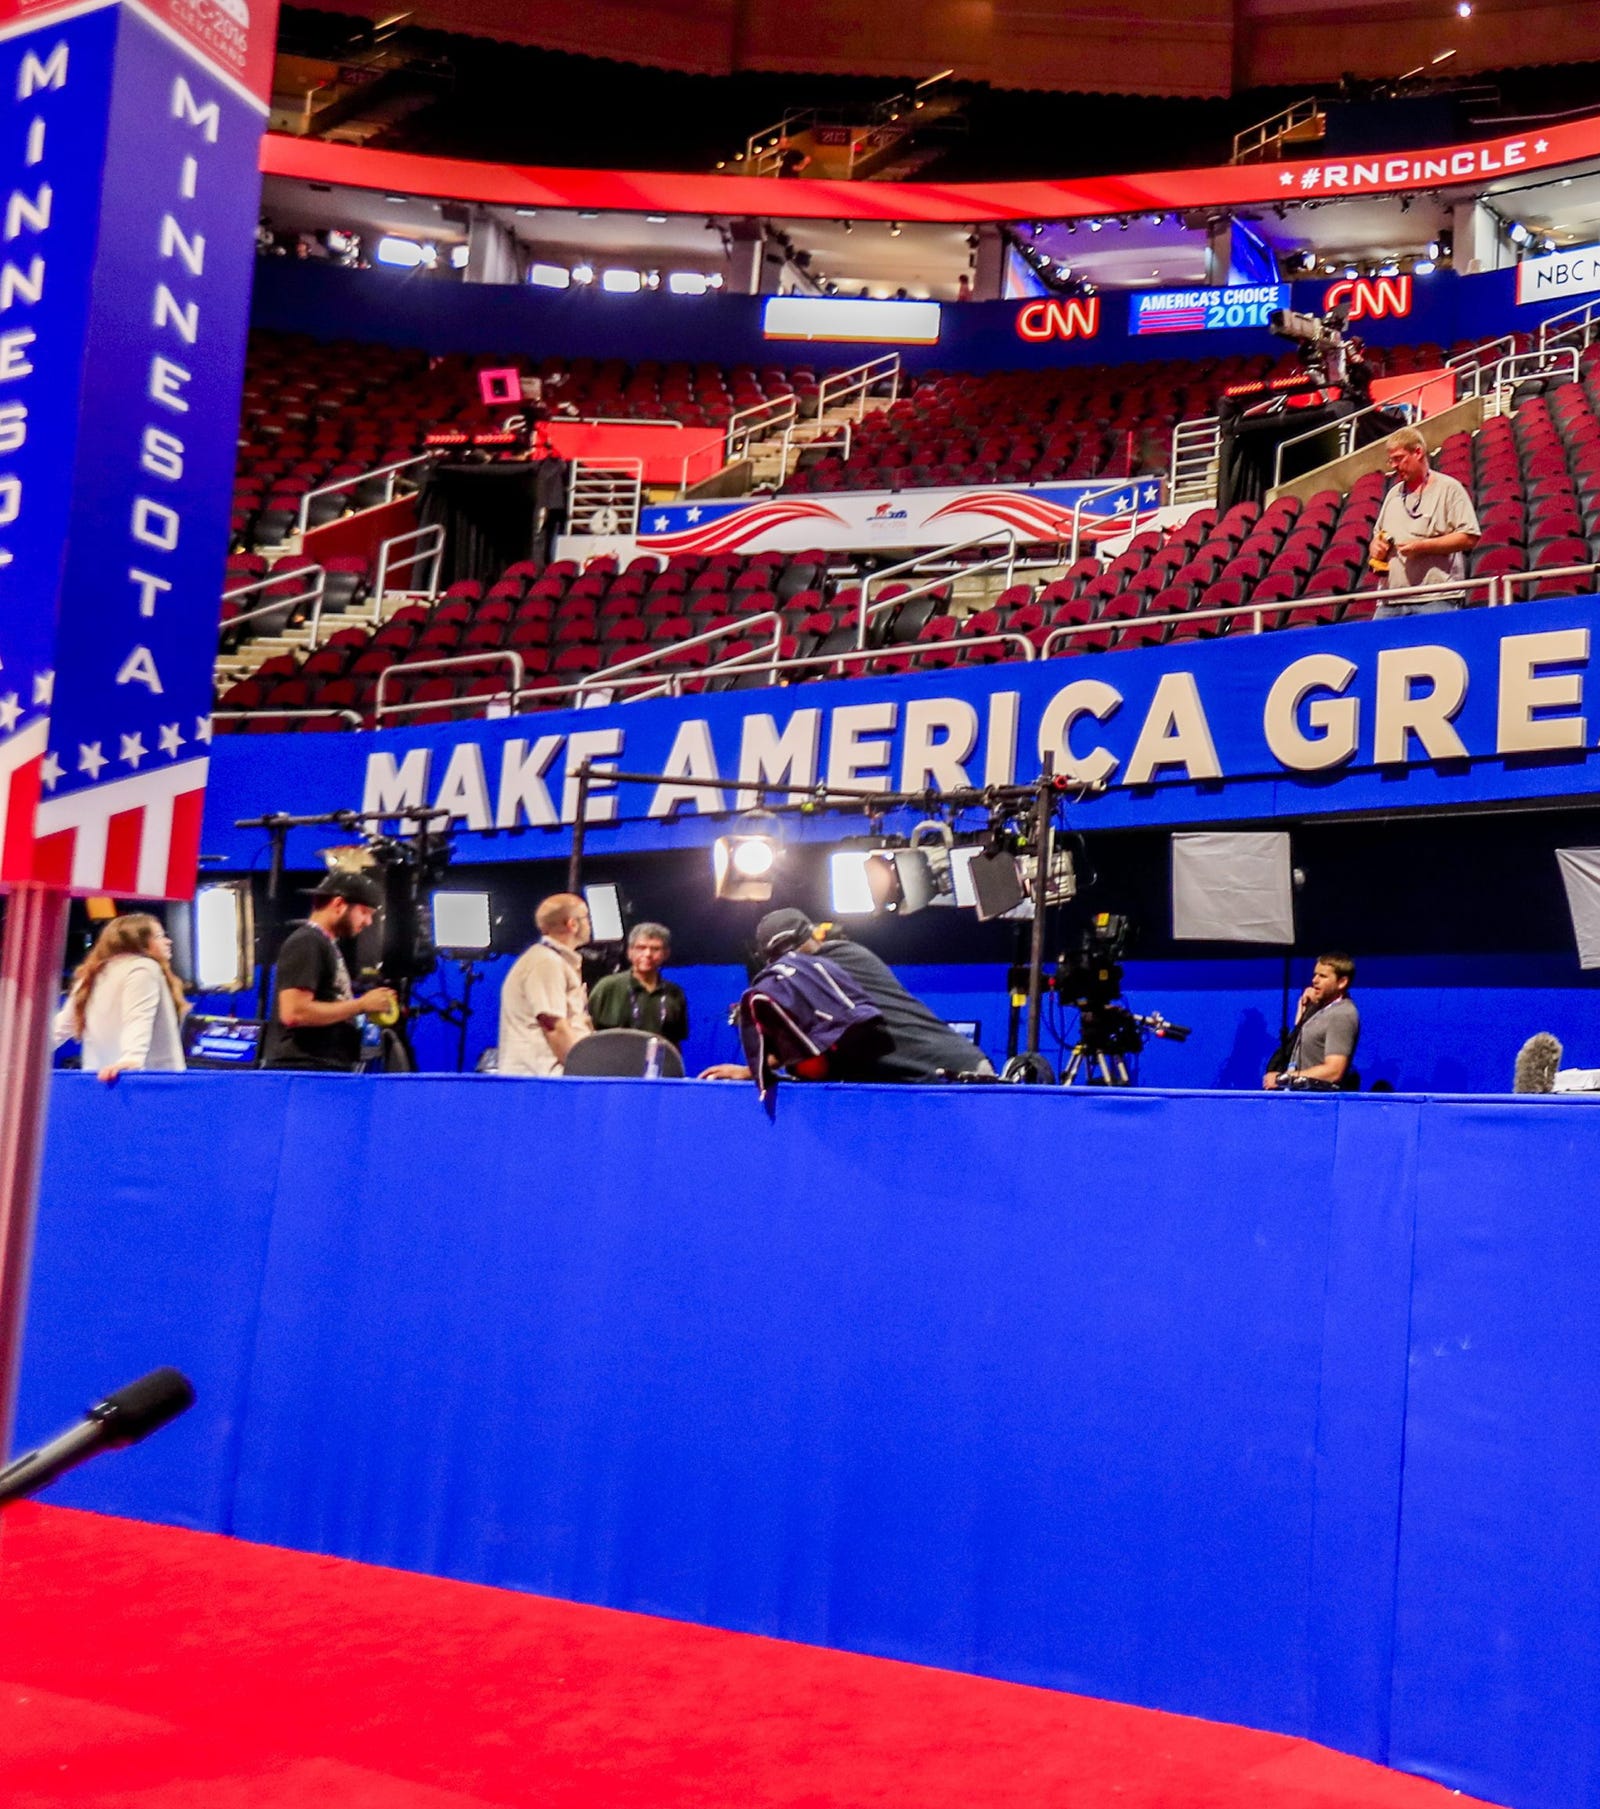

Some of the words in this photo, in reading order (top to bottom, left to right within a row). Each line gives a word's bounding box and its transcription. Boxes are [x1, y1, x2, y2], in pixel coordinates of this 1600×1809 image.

[1536, 260, 1584, 289] NBC
[1139, 290, 1221, 313] AMERICA'S
[1224, 286, 1279, 305] CHOICE
[1323, 275, 1413, 320] CNN
[1016, 298, 1100, 342] CNN
[115, 76, 220, 694] MINNESOTA
[361, 728, 625, 836] MAKE
[647, 671, 1223, 818] AMERICA
